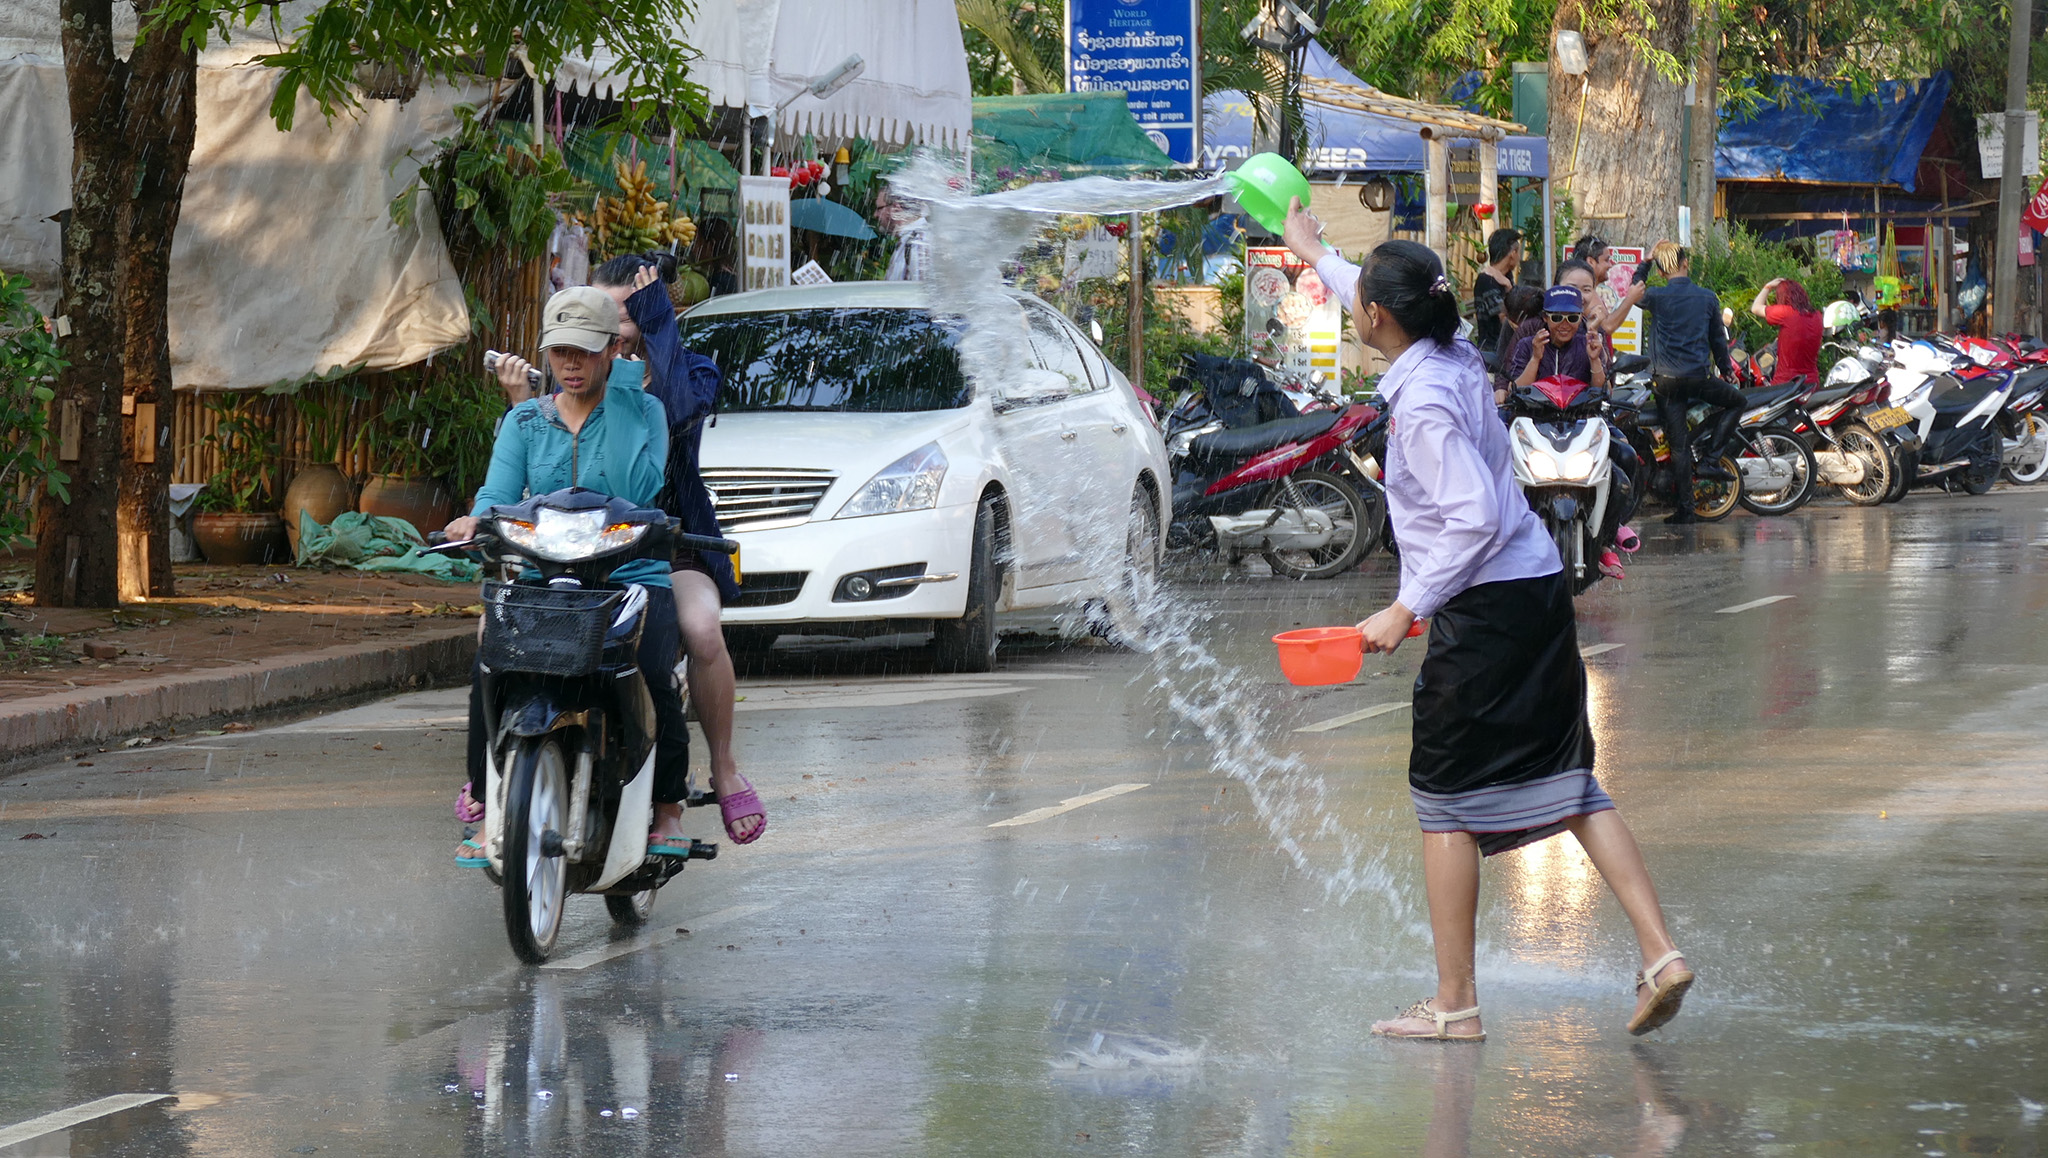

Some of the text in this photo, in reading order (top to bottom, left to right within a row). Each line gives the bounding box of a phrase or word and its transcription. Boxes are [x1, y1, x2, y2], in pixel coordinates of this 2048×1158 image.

[1113, 9, 1147, 18] WORLD
[1108, 18, 1152, 27] HERITAGE
[1509, 148, 1532, 172] TIGER
[1250, 251, 1282, 268] Mekong
